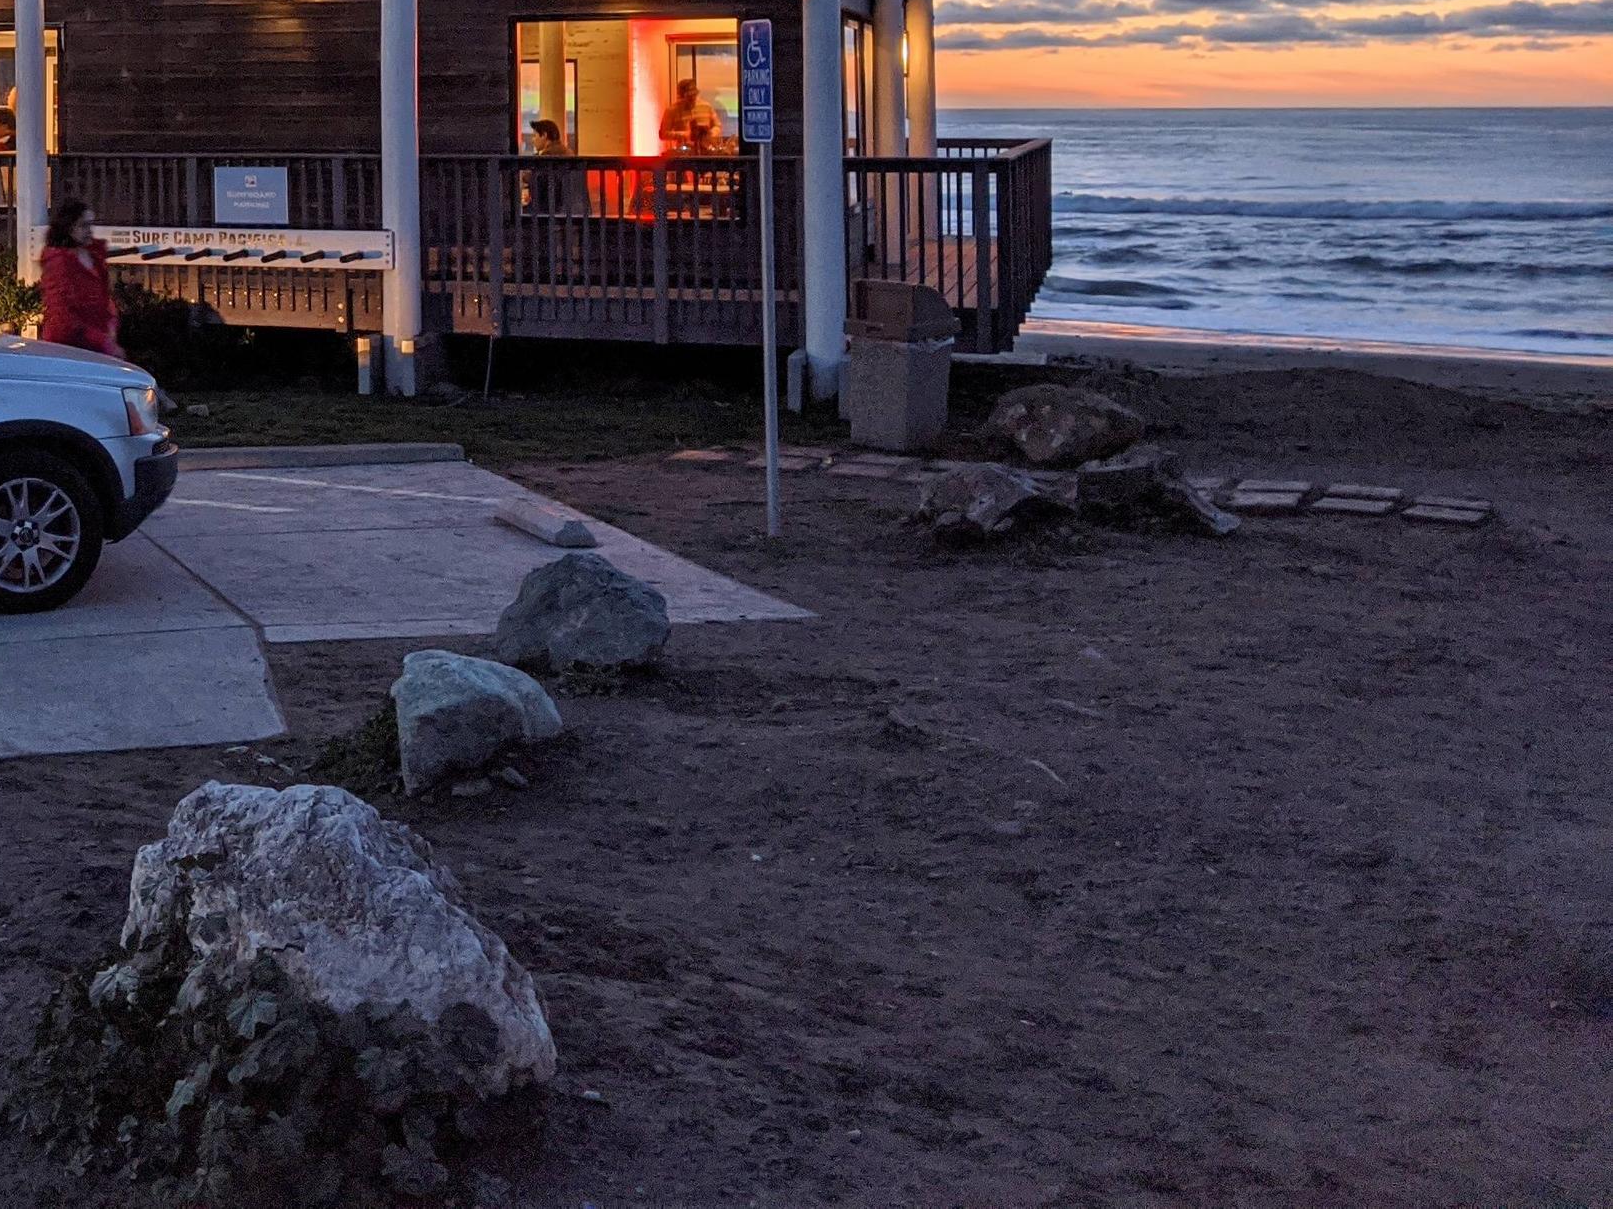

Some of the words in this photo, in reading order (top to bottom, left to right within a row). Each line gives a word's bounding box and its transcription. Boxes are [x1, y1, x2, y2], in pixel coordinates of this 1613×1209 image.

[743, 69, 770, 85] PARKING
[748, 88, 766, 105] ONLY
[132, 230, 170, 245] SURF
[173, 231, 215, 245] CAMP
